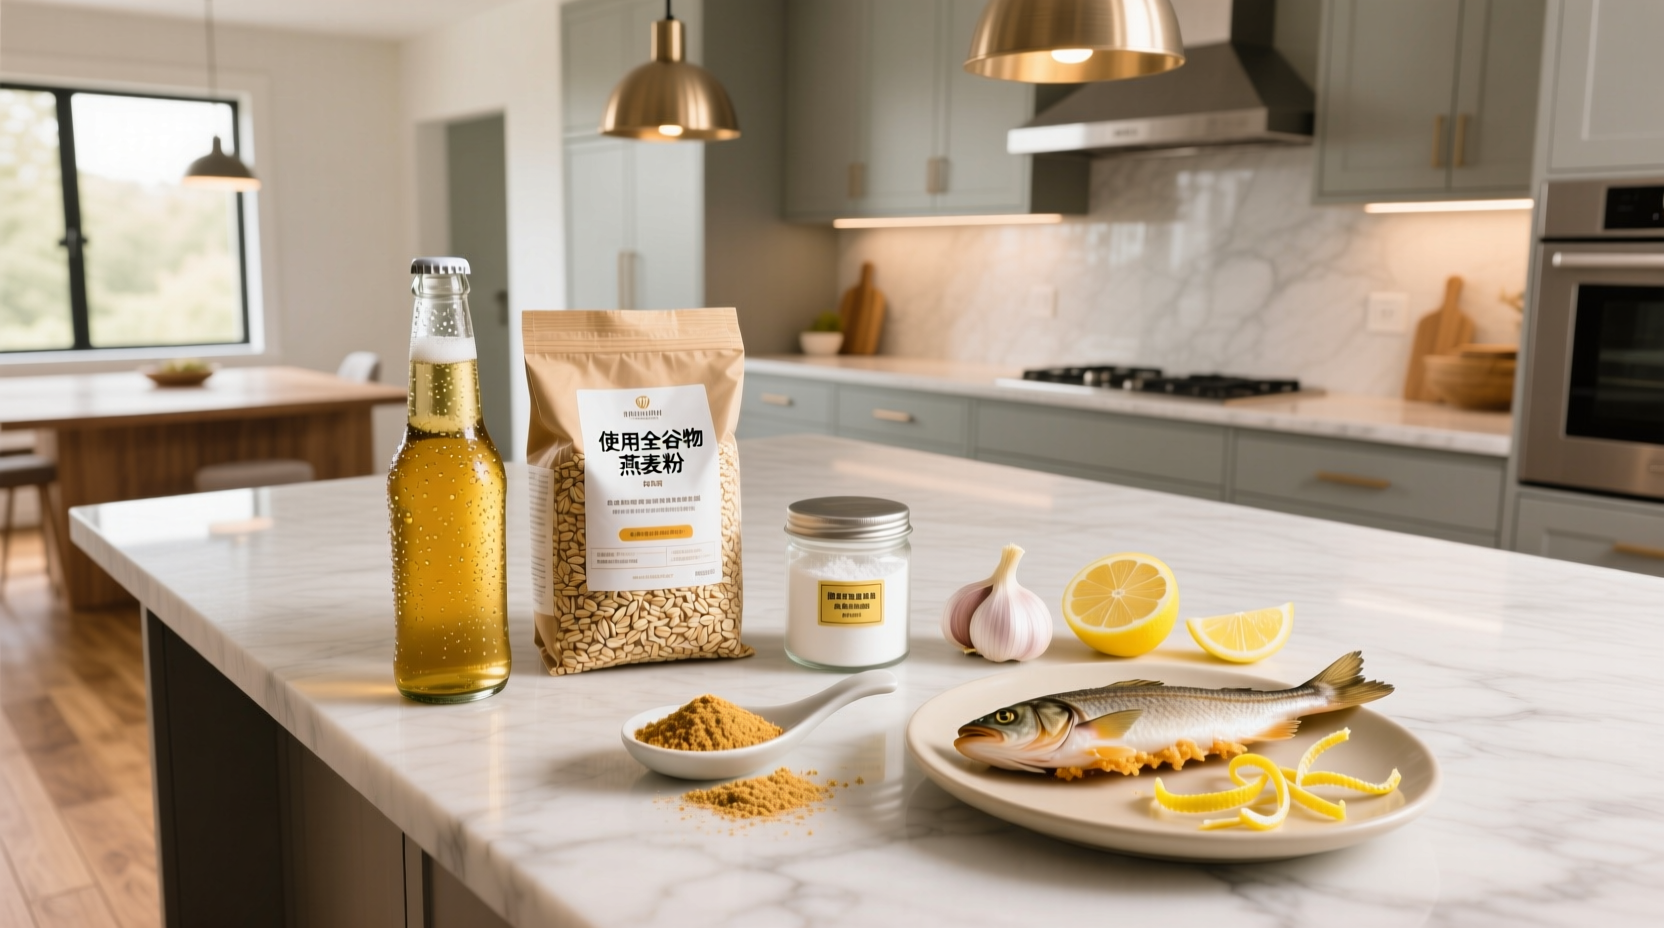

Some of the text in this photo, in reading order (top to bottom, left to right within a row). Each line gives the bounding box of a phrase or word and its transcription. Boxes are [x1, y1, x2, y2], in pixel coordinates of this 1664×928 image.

[599, 428, 703, 452] 使用全谷物
[619, 452, 684, 476] 燕麦粉
